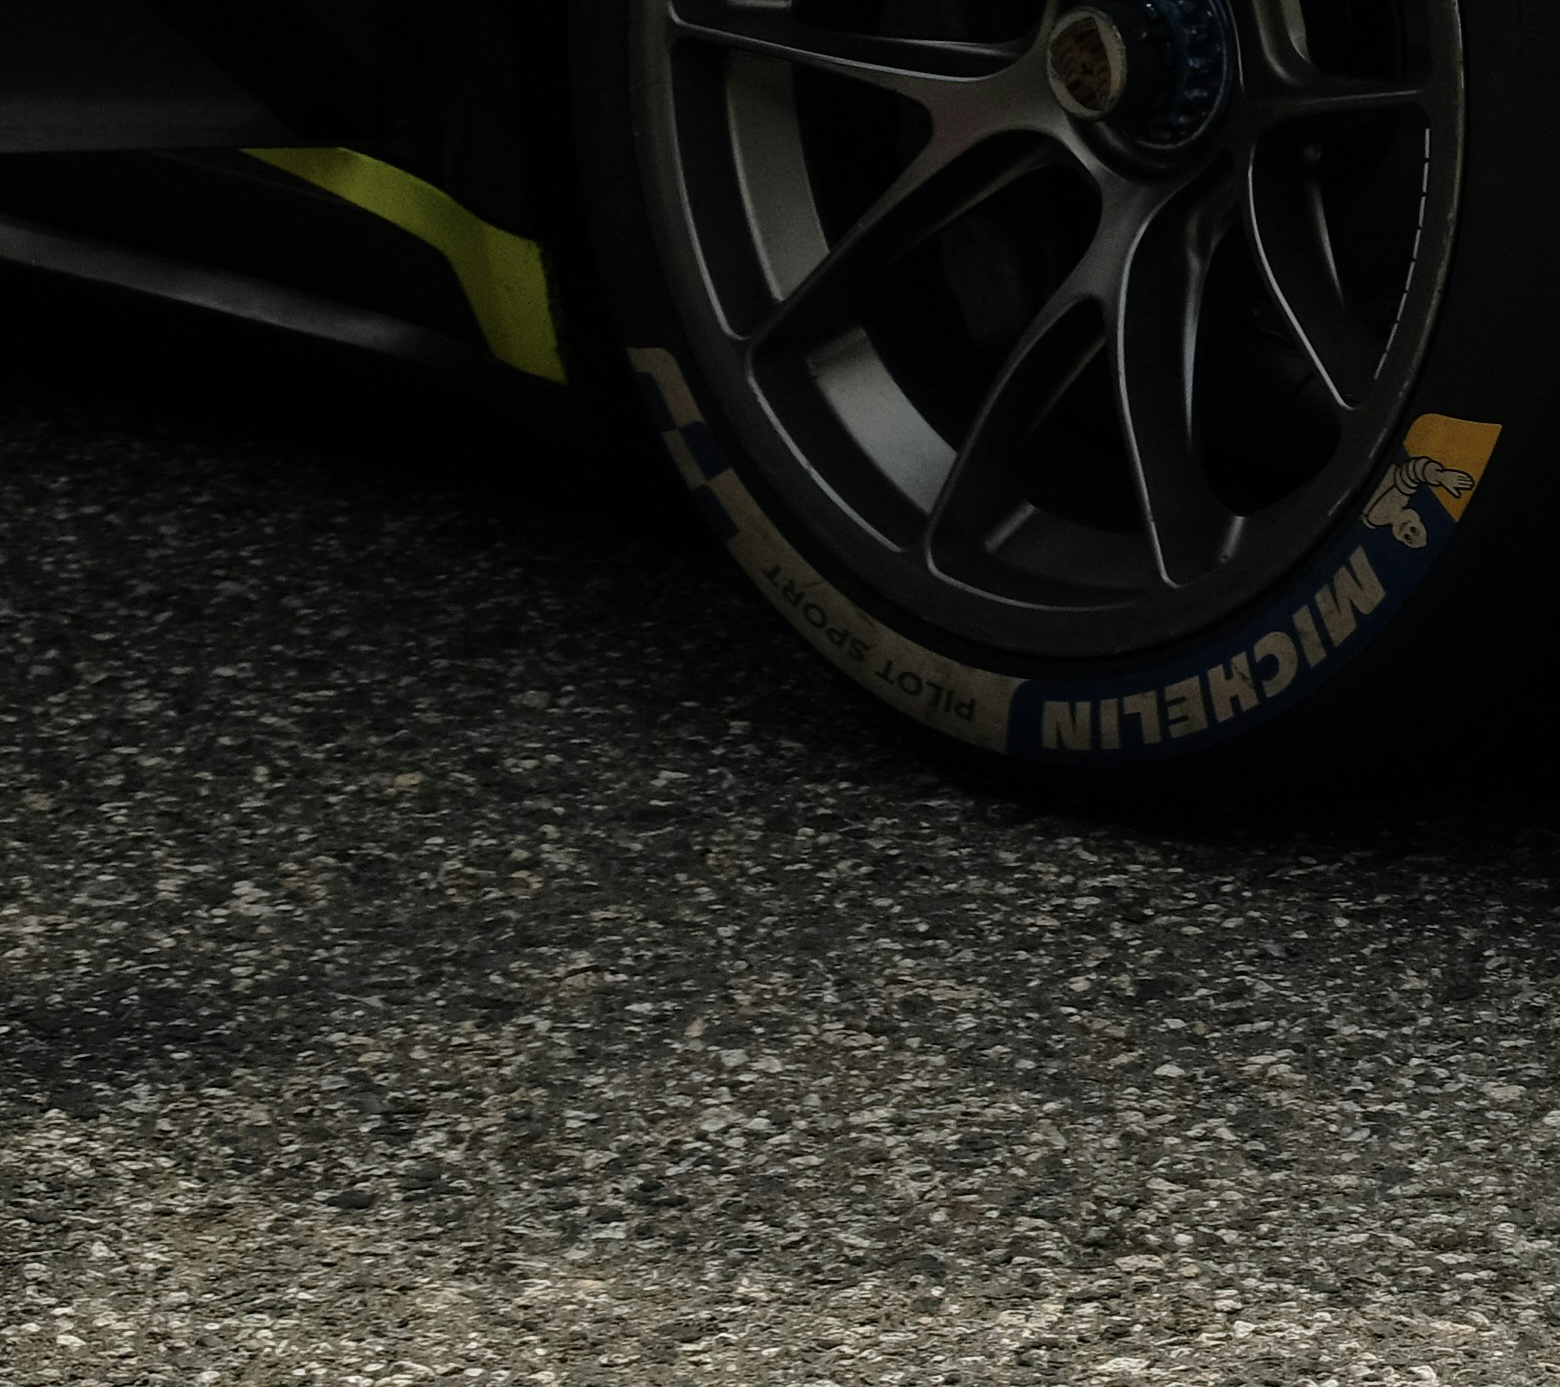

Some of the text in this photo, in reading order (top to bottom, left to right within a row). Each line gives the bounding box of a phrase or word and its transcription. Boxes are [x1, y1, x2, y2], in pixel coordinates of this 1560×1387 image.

[762, 565, 976, 723] PILOT SPORT
[1040, 546, 1387, 751] MICHELIN
